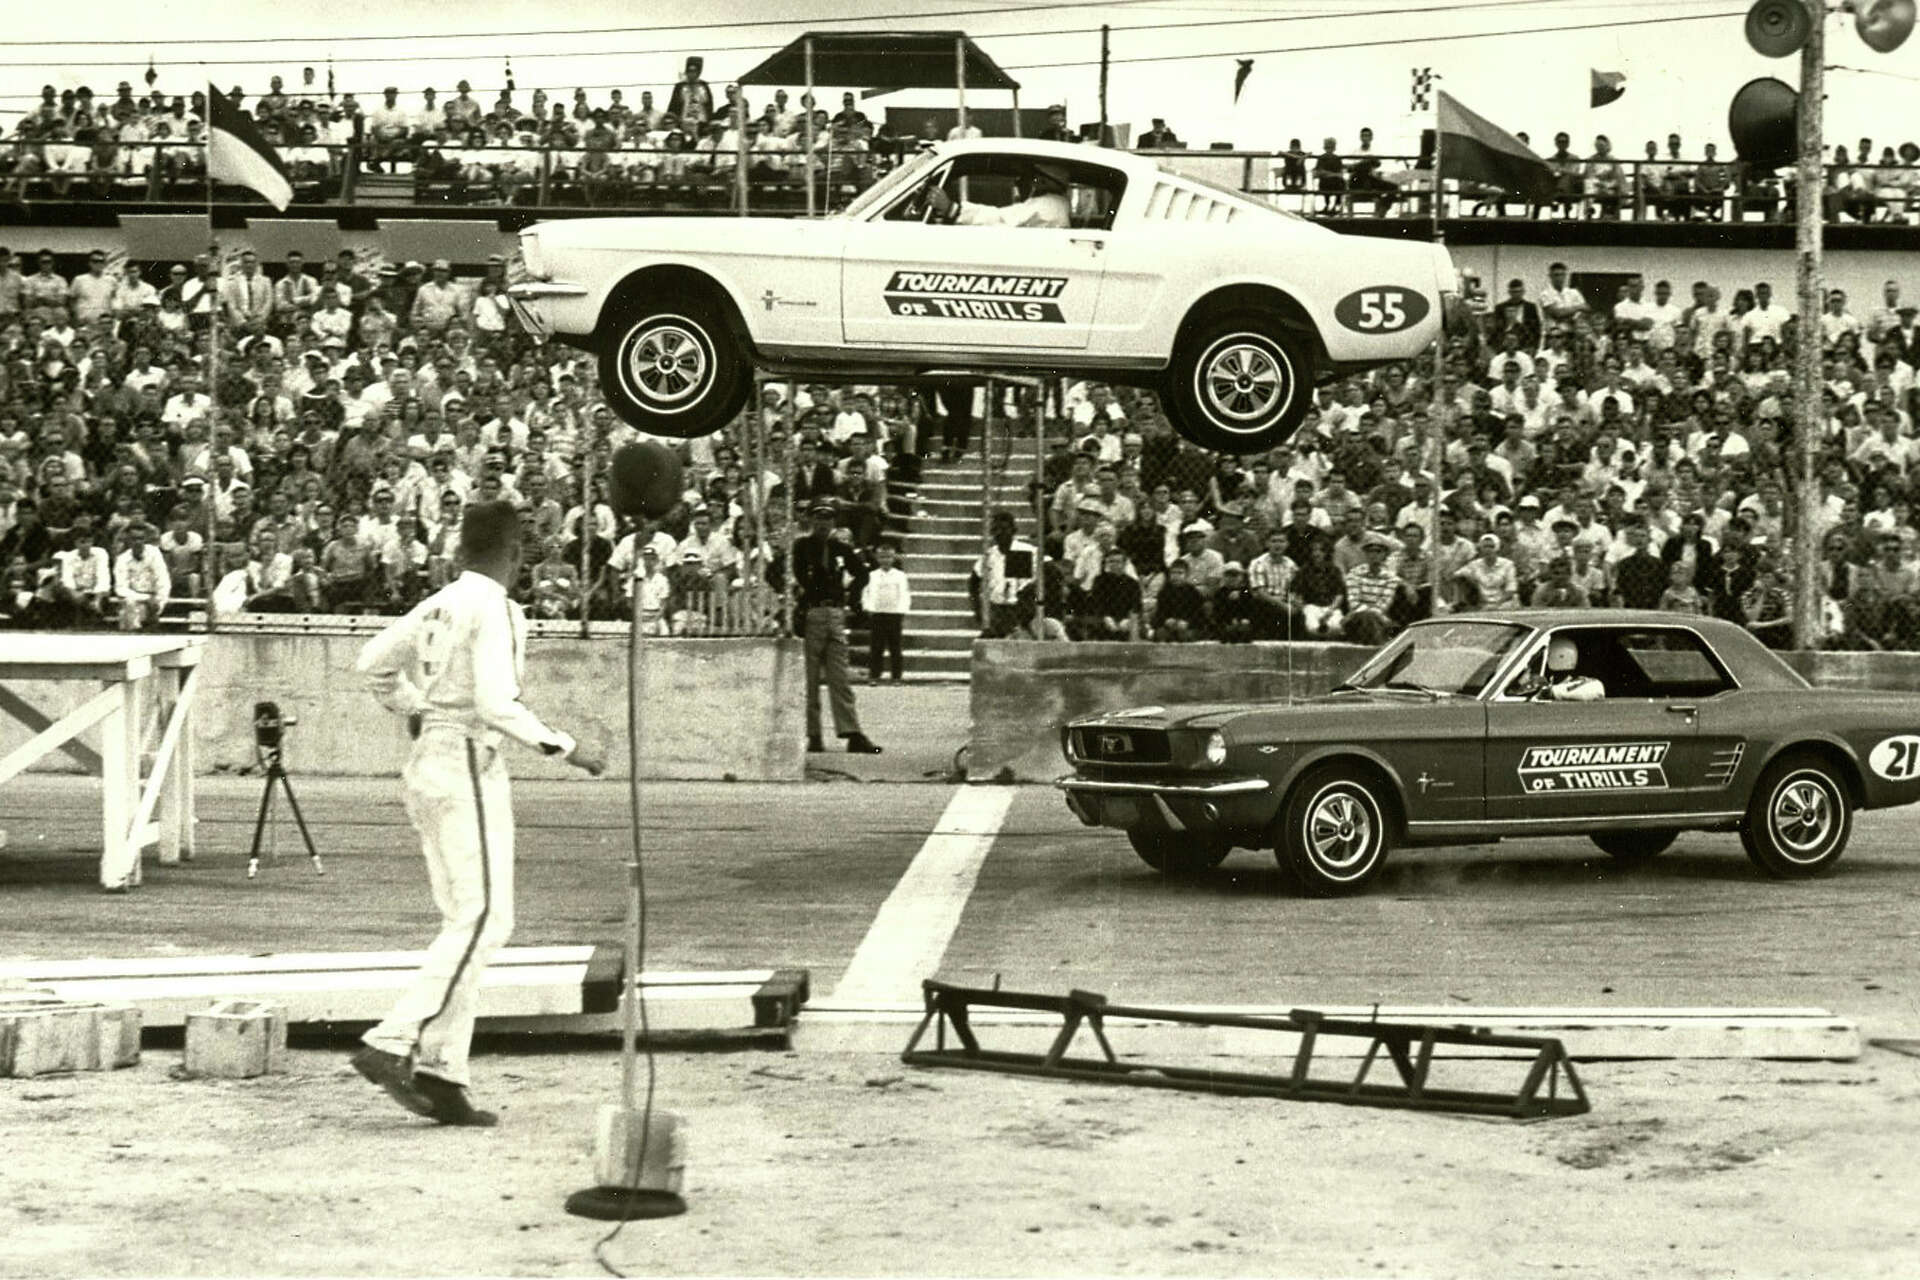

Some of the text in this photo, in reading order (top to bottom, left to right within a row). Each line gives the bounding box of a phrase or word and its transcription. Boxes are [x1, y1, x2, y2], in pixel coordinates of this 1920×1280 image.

[896, 273, 1065, 297] TOURNAMENT
[899, 299, 1044, 321] OF THRILLS
[1358, 292, 1406, 329] 55
[1530, 745, 1665, 767] TOURNAMENT
[1532, 769, 1649, 790] OF THRILLS
